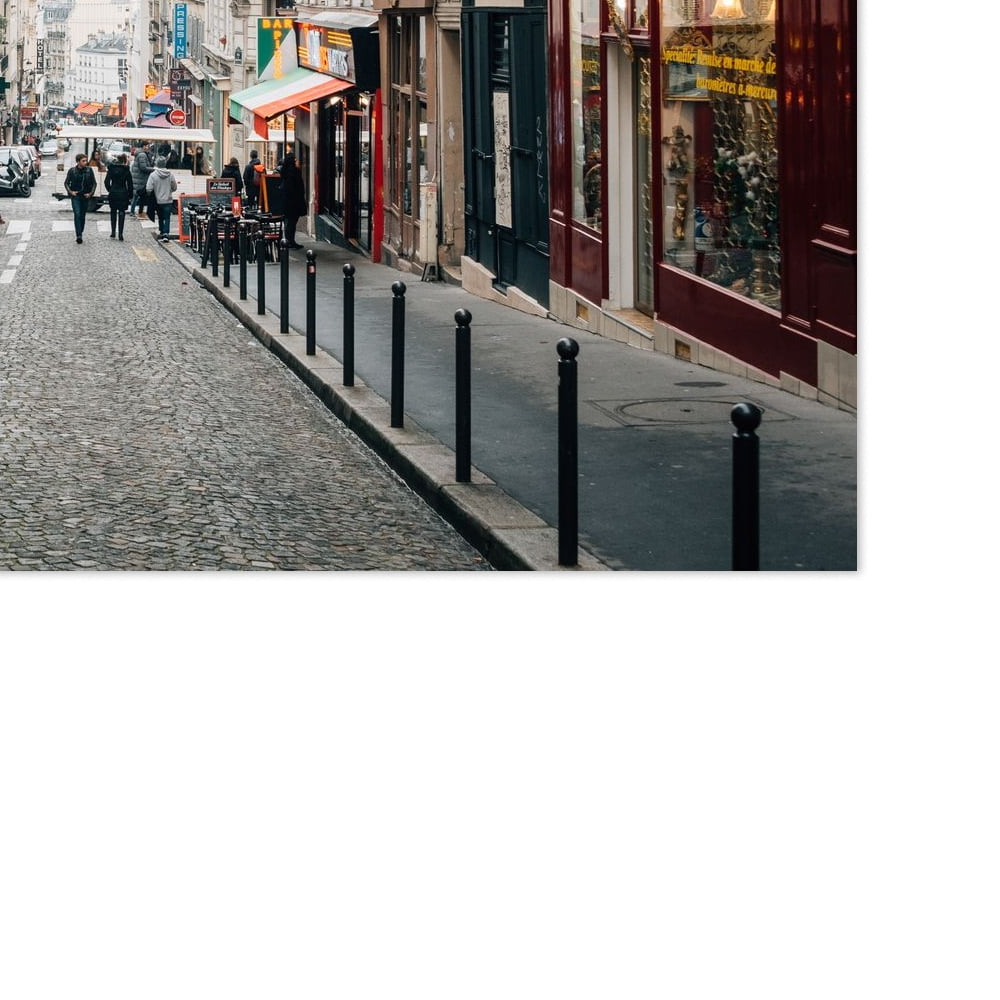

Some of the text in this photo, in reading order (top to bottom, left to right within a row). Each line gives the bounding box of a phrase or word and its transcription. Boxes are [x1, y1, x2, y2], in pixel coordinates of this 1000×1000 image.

[176, 4, 185, 59] PRESSING
[262, 19, 293, 29] BAR
[723, 56, 732, 69] en
[734, 54, 764, 73] marche
[765, 56, 777, 74] de
